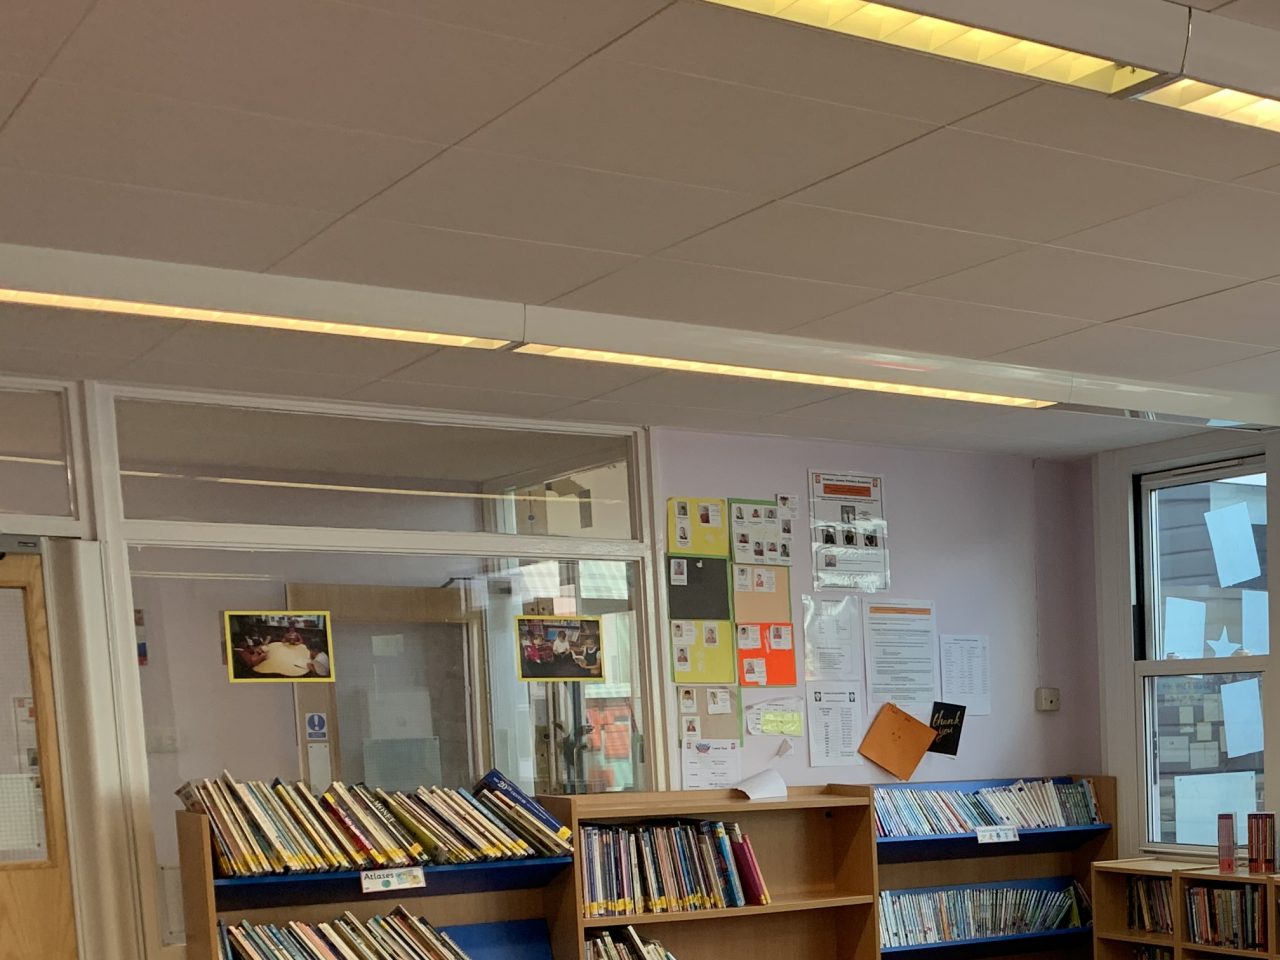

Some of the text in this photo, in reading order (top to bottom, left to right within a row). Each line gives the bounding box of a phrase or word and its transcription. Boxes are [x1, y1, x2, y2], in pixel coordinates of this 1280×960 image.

[933, 710, 961, 727] thank
[936, 727, 953, 742] you
[373, 799, 396, 823] MONET
[364, 872, 394, 881] Atlases
